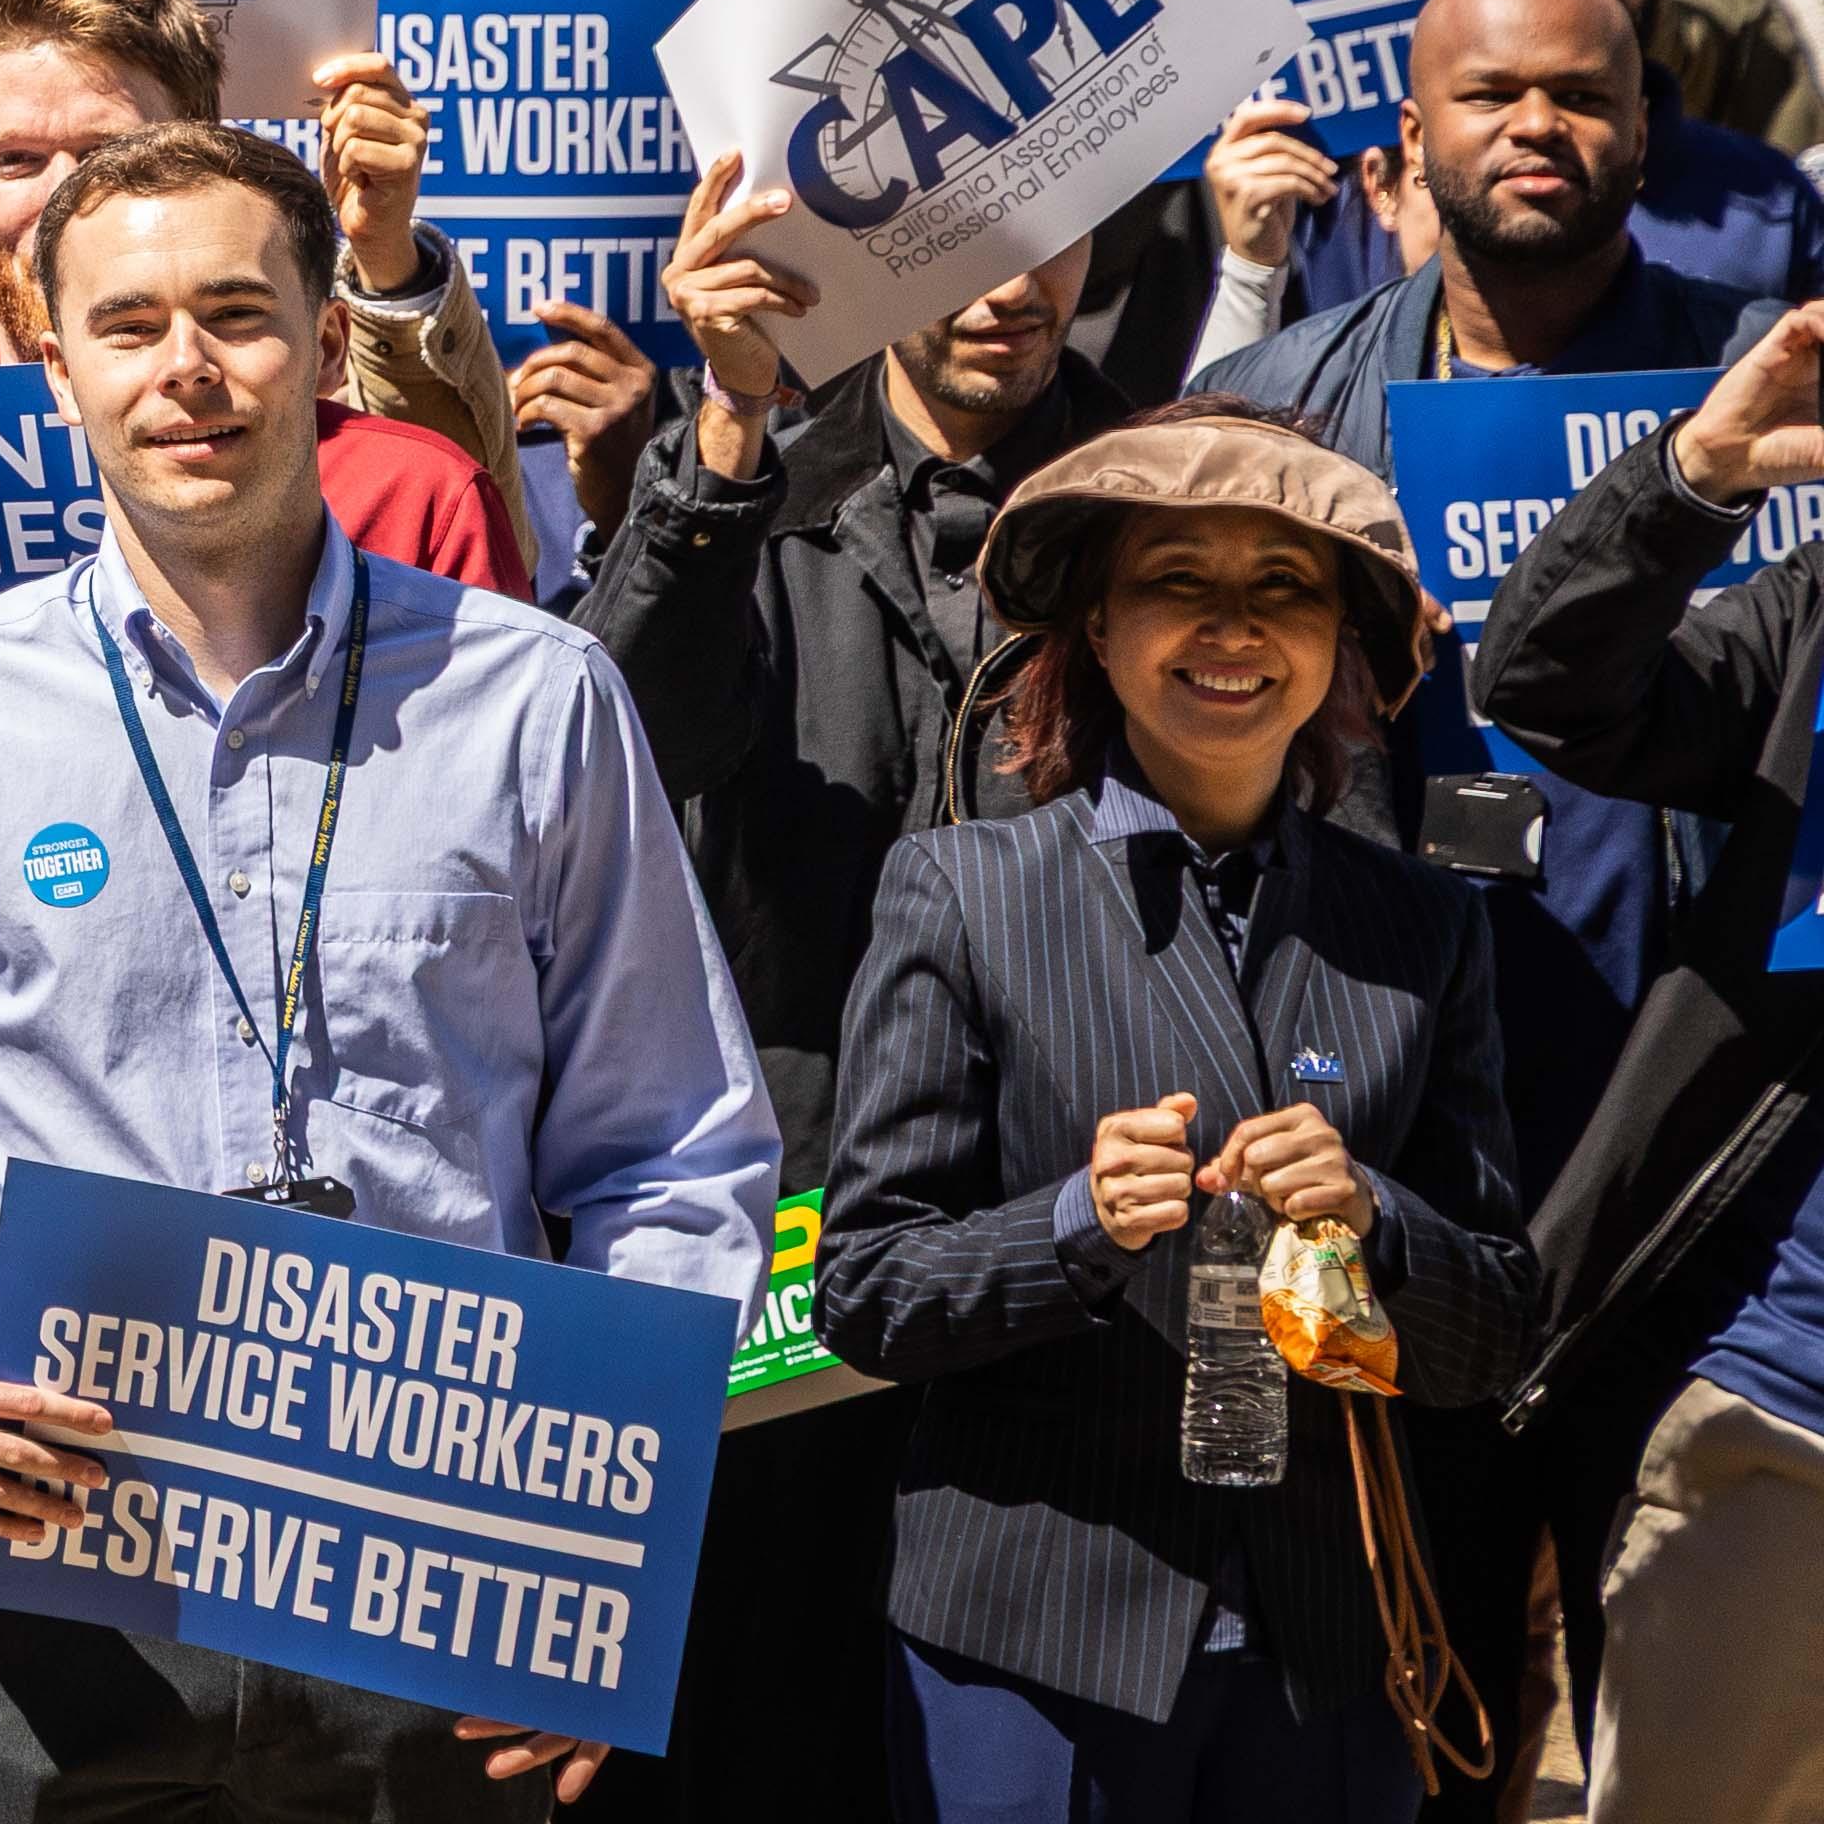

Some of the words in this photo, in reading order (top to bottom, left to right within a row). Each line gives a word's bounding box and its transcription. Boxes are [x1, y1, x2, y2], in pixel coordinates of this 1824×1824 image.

[381, 13, 609, 93] ISASTER
[458, 96, 693, 175] WORKER
[864, 173, 995, 257] California
[999, 63, 1139, 176] Association
[1141, 34, 1167, 67] of
[885, 176, 1046, 278] Professional
[1042, 65, 1179, 179] Employees
[506, 238, 679, 325] BETTE
[24, 848, 103, 881] TOGETHER
[31, 837, 90, 856] STRONGER
[314, 832, 329, 866] Works
[57, 885, 79, 896] CAPE
[288, 960, 304, 994] Public
[296, 923, 309, 958] COUNTY
[283, 995, 296, 1029] Works
[197, 1238, 524, 1390] DISASTER
[33, 1307, 312, 1442] SERVICE
[327, 1361, 660, 1516] WORKERS
[351, 1533, 630, 1690] BETTER
